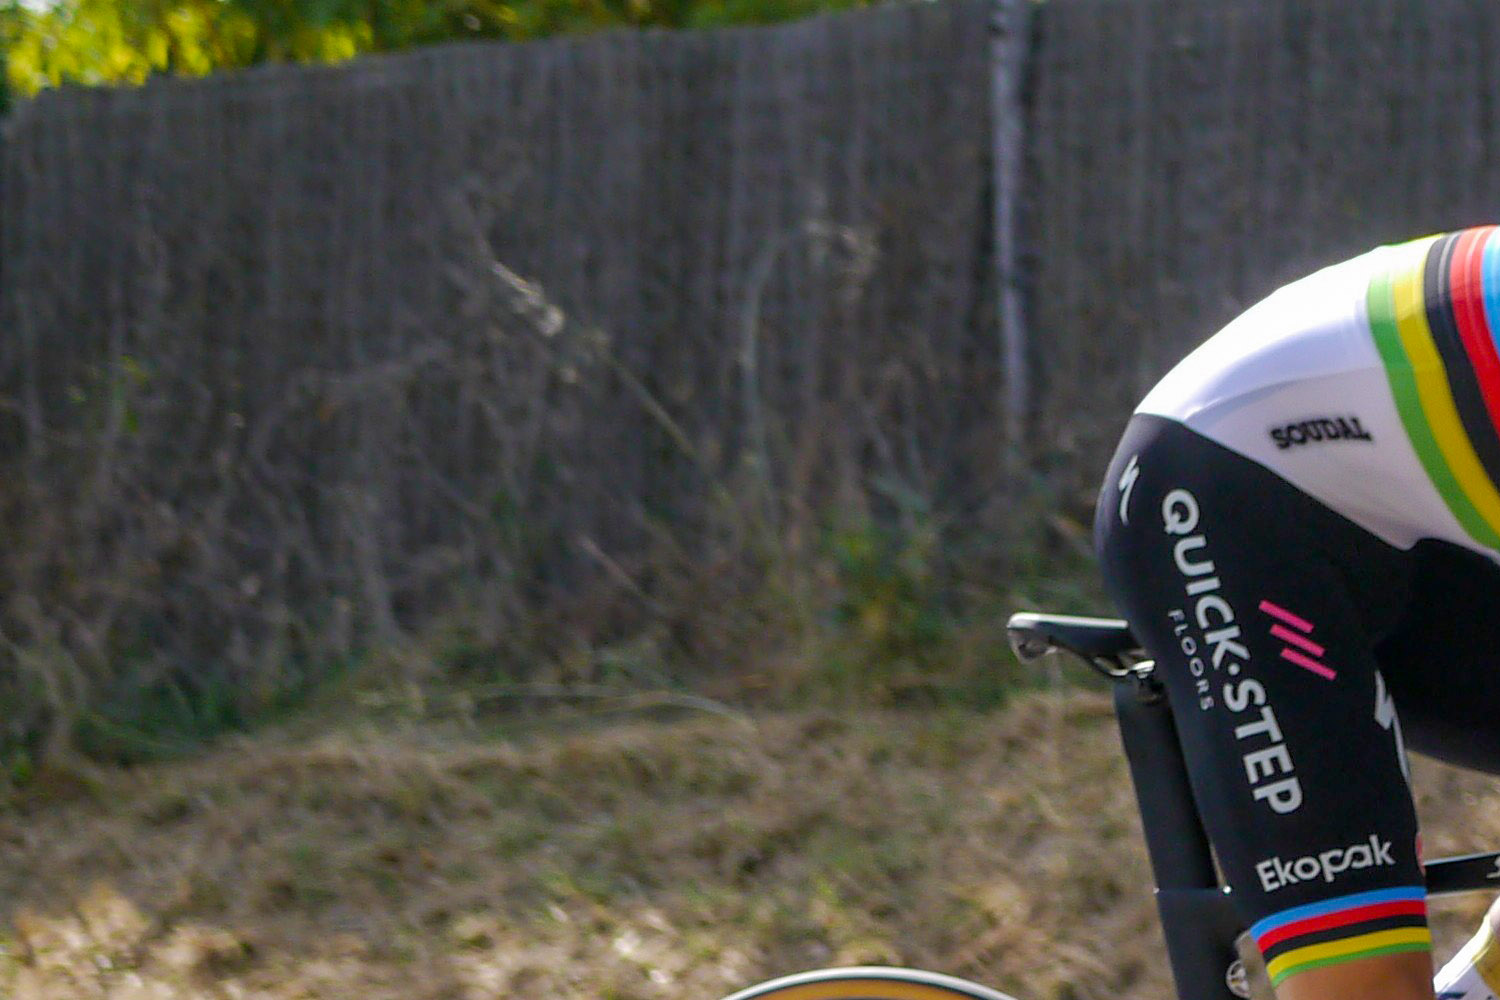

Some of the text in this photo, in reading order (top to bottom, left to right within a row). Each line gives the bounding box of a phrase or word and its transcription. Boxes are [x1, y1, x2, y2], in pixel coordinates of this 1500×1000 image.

[1269, 415, 1373, 450] SOUDAL
[1168, 610, 1214, 711] FLOORS
[1255, 835, 1396, 892] Ekopak
